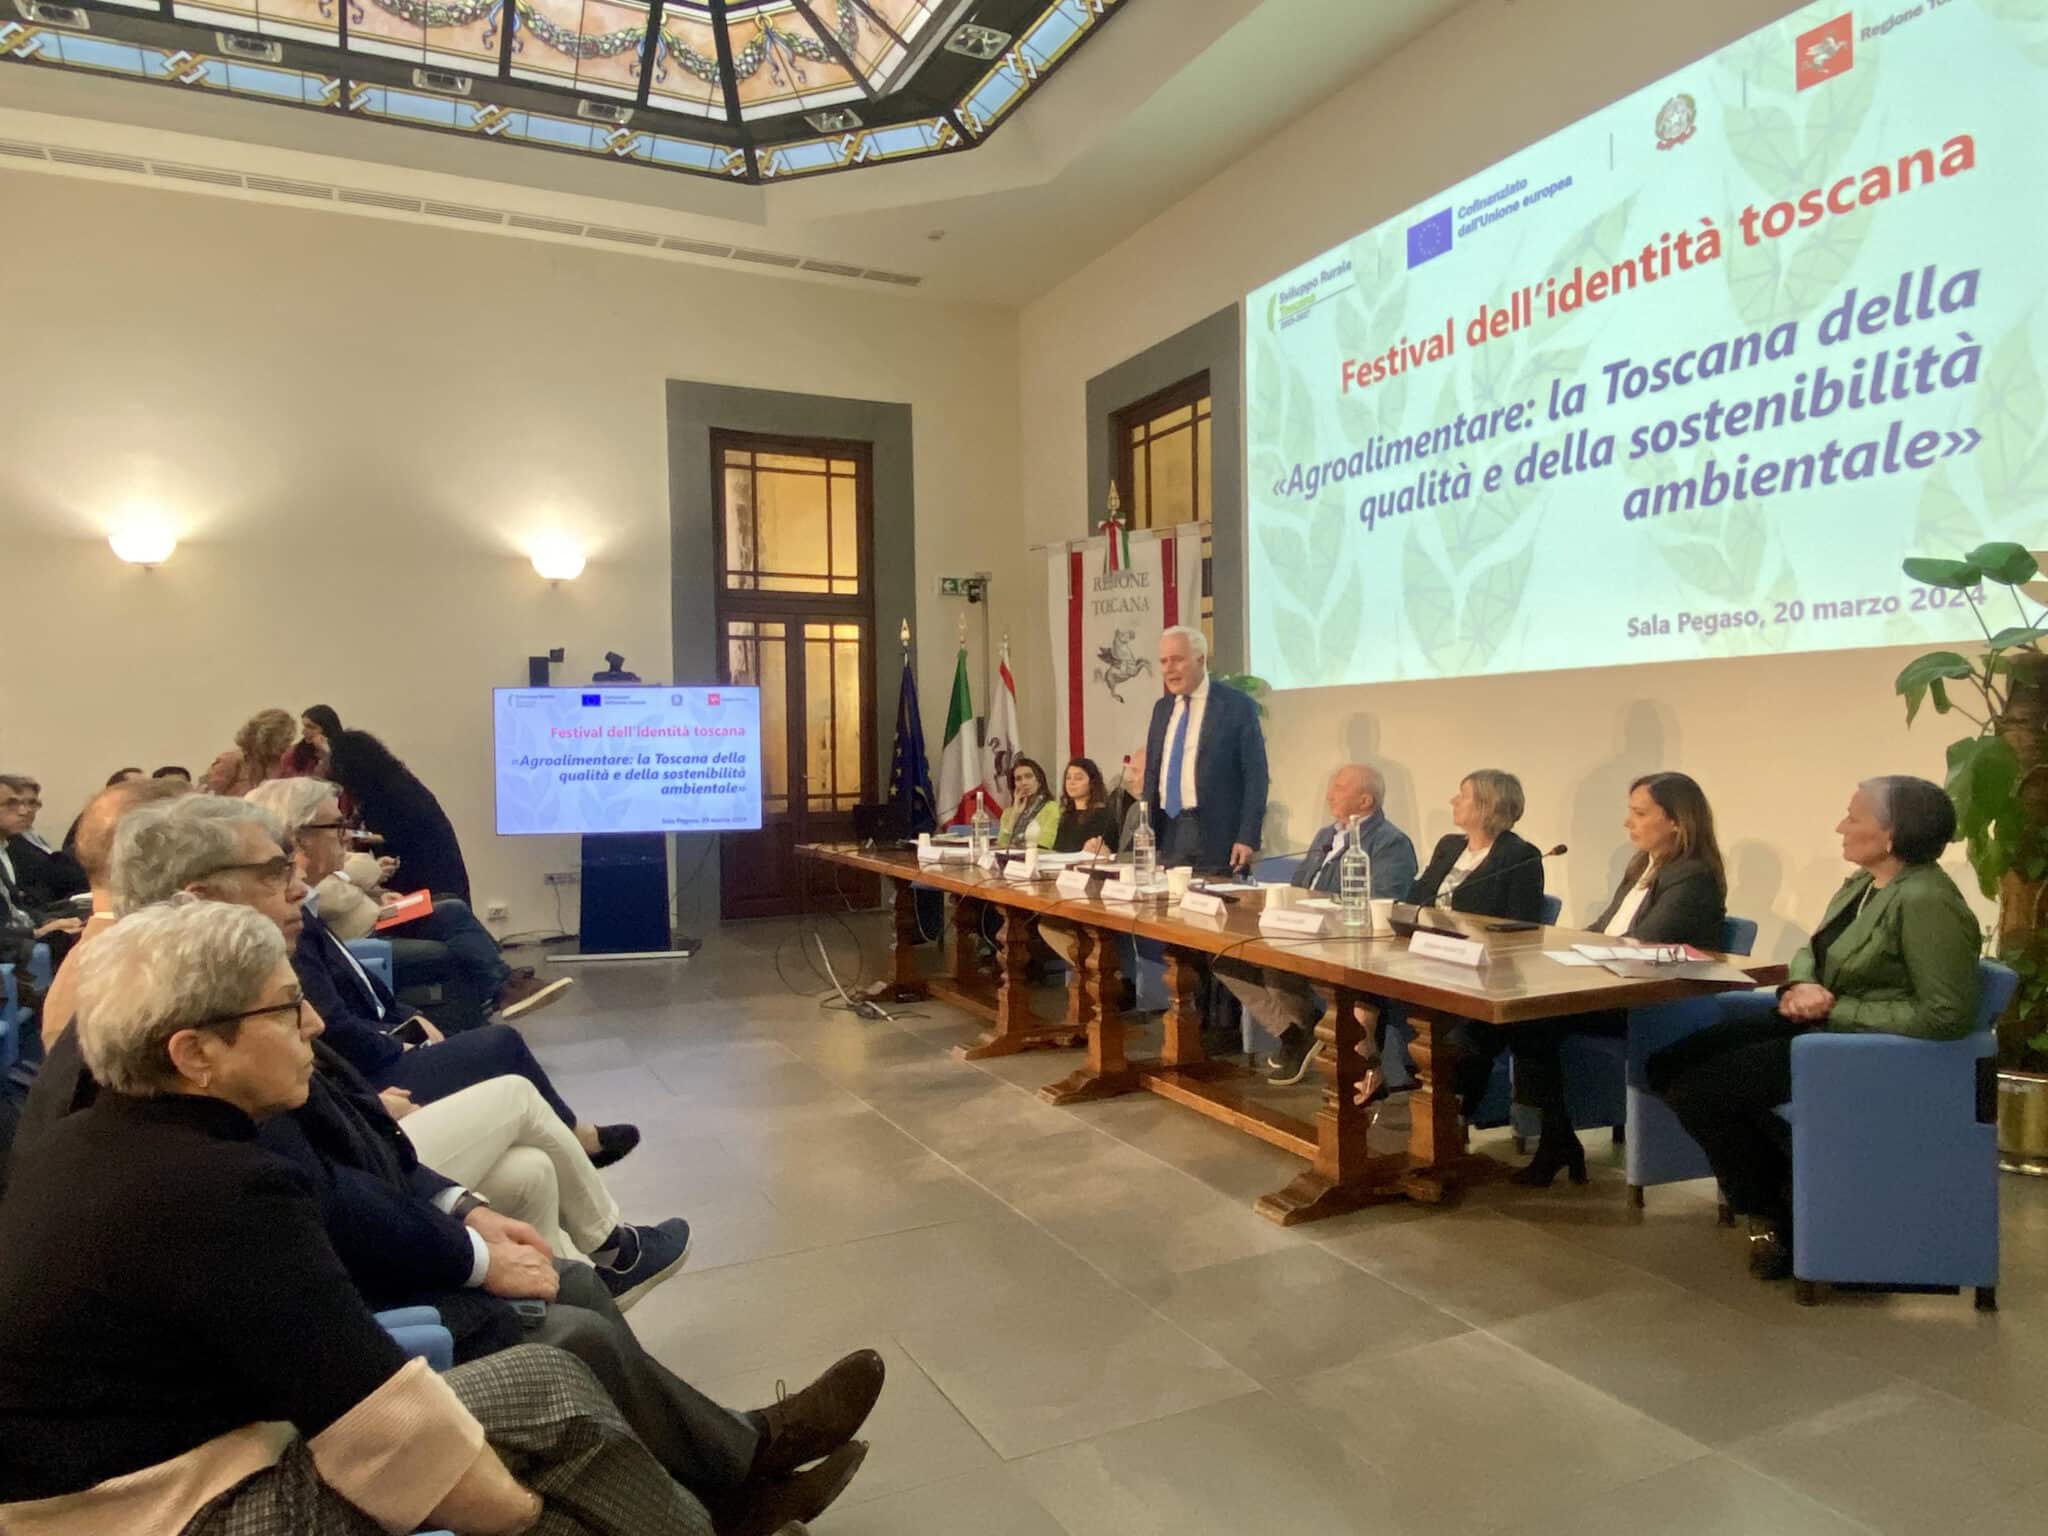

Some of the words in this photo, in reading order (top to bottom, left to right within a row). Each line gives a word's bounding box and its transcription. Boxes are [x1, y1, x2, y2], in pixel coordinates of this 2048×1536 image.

[1860, 5, 1923, 41] Regione
[1457, 178, 1528, 219] Cofinanziato
[1522, 175, 1573, 207] europea
[1341, 316, 1454, 395] Festival
[1738, 133, 1976, 247] toscana
[1271, 399, 1536, 500] «Agroalimentare:
[1548, 378, 1587, 421] la
[1602, 320, 1798, 405] Toscana
[1817, 263, 1981, 346] della
[1359, 462, 1472, 532] qualità
[1482, 463, 1503, 493] e
[1514, 428, 1616, 486] della
[1628, 330, 1983, 460] sostenibilità
[1622, 419, 1983, 522] ambientale»
[1626, 615, 1671, 638] Sala
[1677, 607, 1766, 636] Pegaso,
[1774, 600, 1805, 624] 20
[1812, 594, 1900, 622] marzo
[1909, 583, 1988, 612] 2024
[550, 727, 603, 739] Festival
[694, 726, 746, 737] toscana
[559, 769, 609, 784] qualità
[613, 772, 622, 780] e
[625, 769, 659, 780] della
[637, 754, 651, 765] la
[655, 753, 708, 765] Toscana
[712, 752, 746, 764] della
